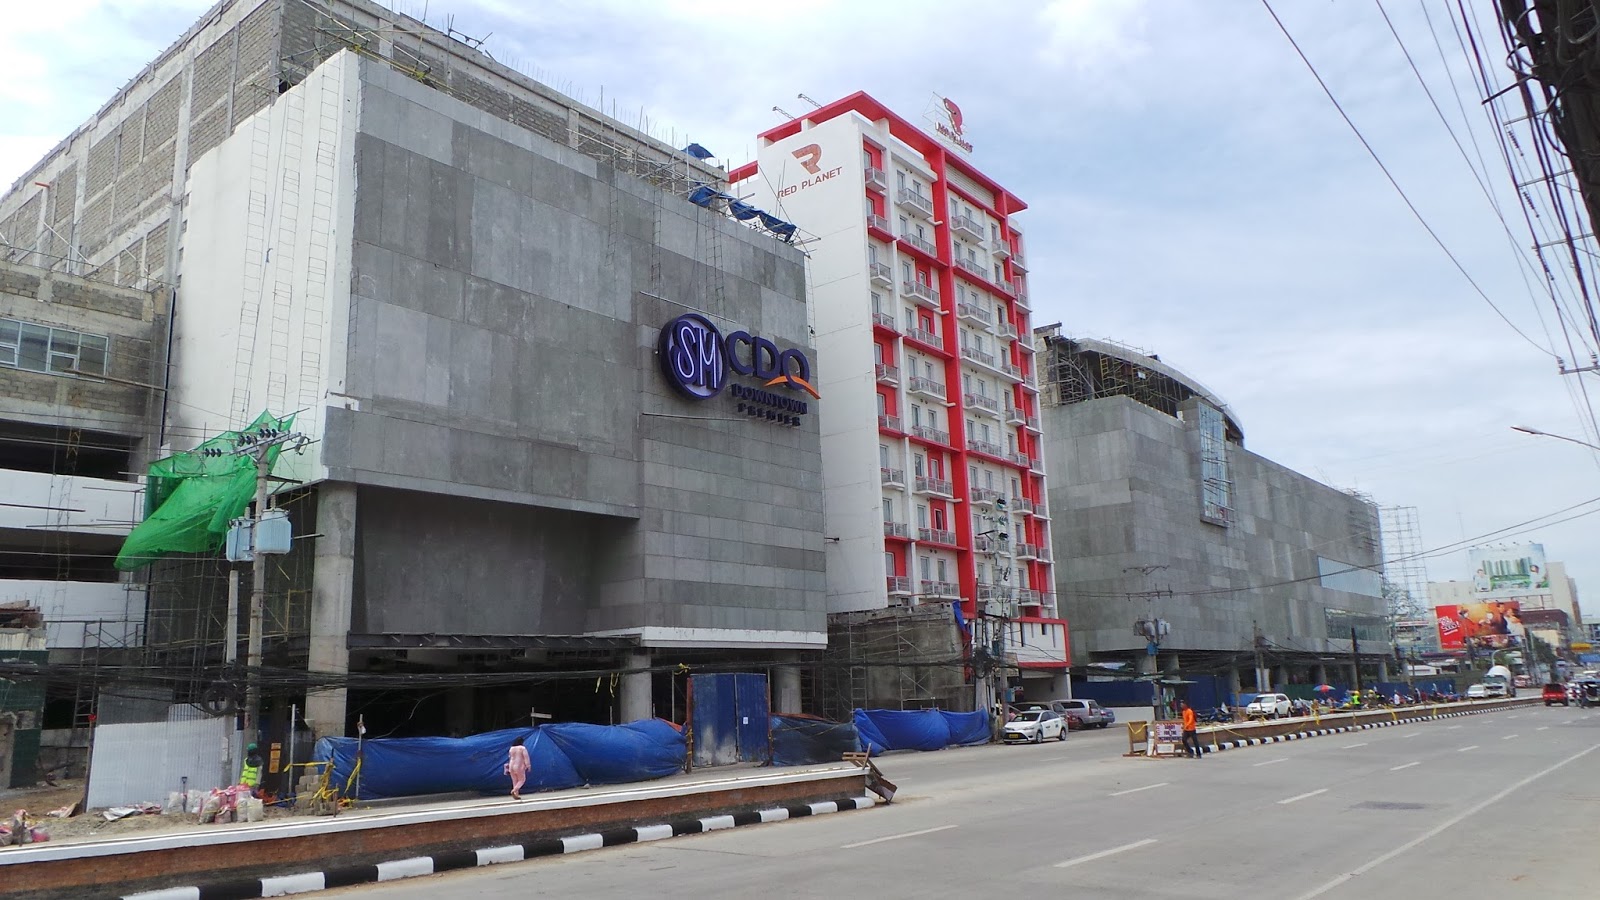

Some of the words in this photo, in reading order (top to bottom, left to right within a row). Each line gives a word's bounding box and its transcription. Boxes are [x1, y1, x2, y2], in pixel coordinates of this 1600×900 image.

[777, 185, 798, 199] RED
[801, 166, 843, 190] PLANET
[668, 319, 720, 392] SM
[725, 330, 810, 391] CDO
[731, 383, 808, 414] DOWNTOWN
[737, 402, 801, 427] PREMIER
